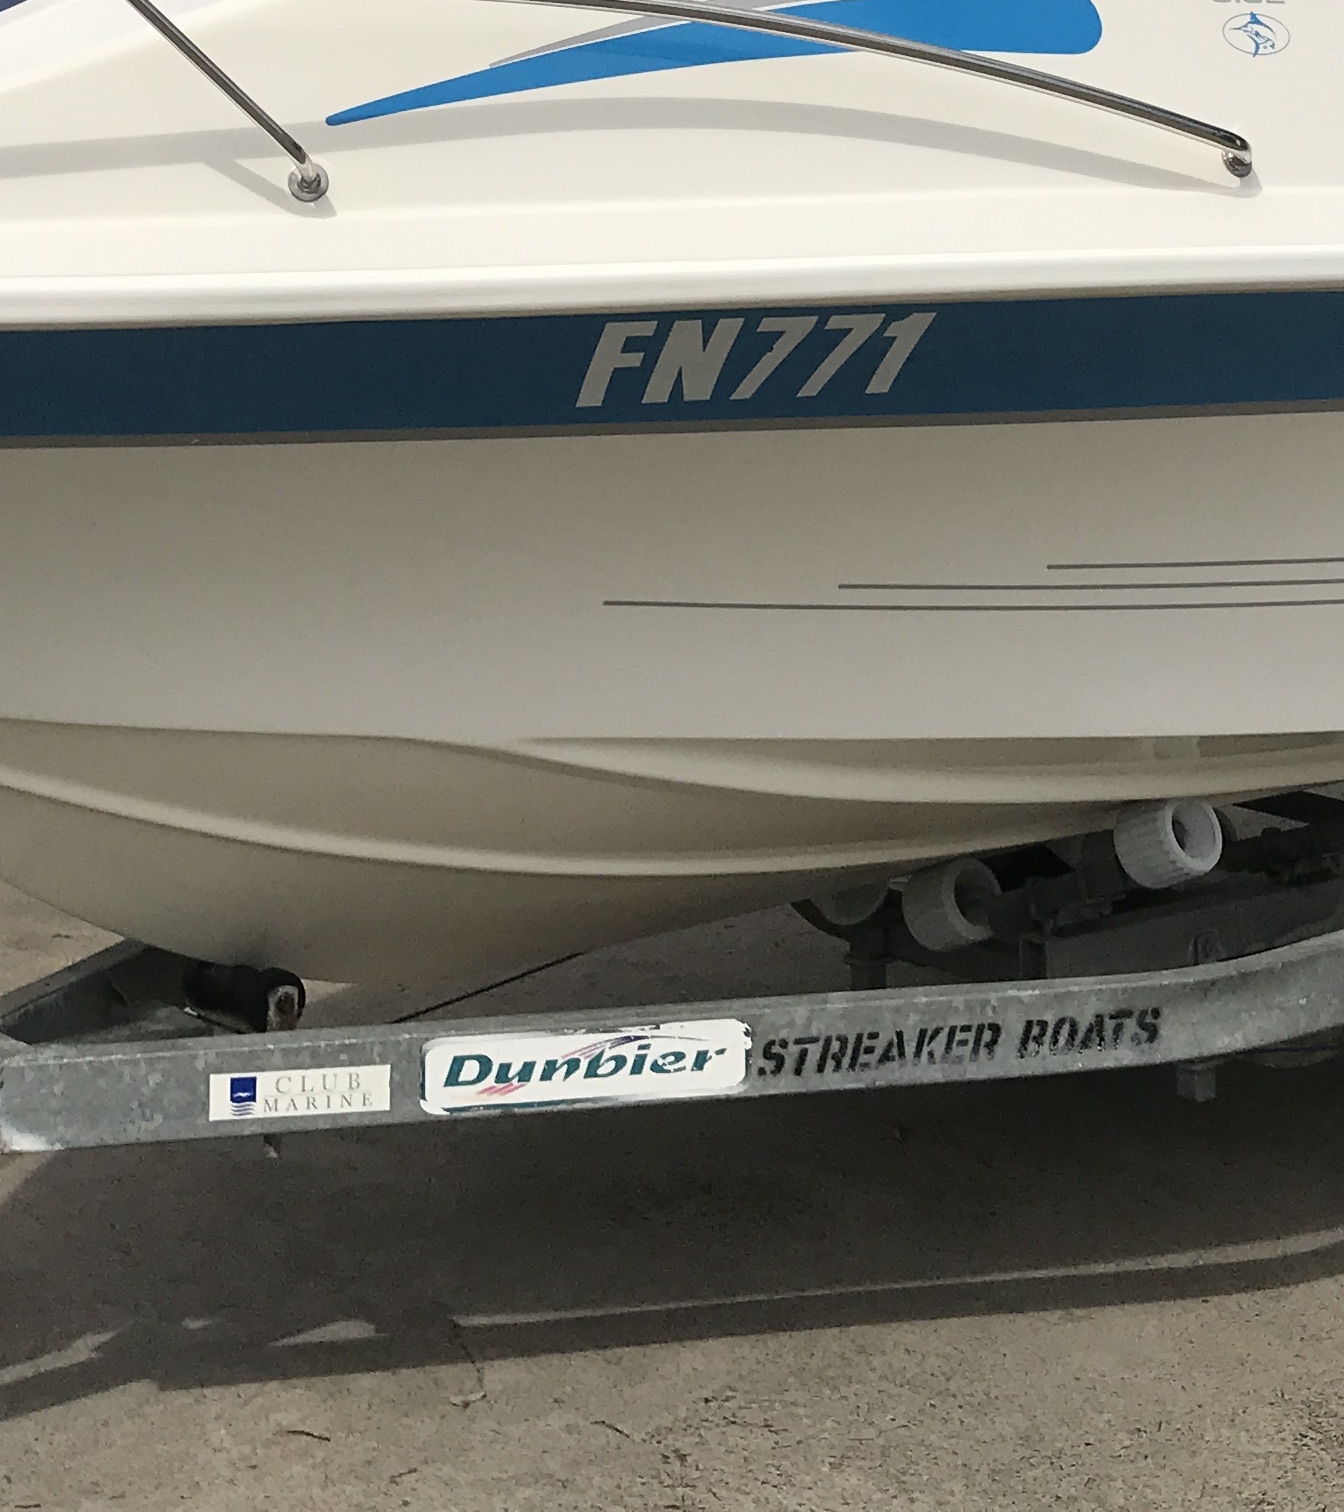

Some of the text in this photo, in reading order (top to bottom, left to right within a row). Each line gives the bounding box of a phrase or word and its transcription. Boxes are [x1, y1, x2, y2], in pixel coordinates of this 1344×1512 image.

[575, 312, 937, 408] FN771
[443, 1040, 726, 1088] Dunbier
[758, 1007, 1162, 1077] STREAKER BOATS
[263, 1093, 373, 1113] MARINE
[275, 1072, 361, 1094] CLUB
